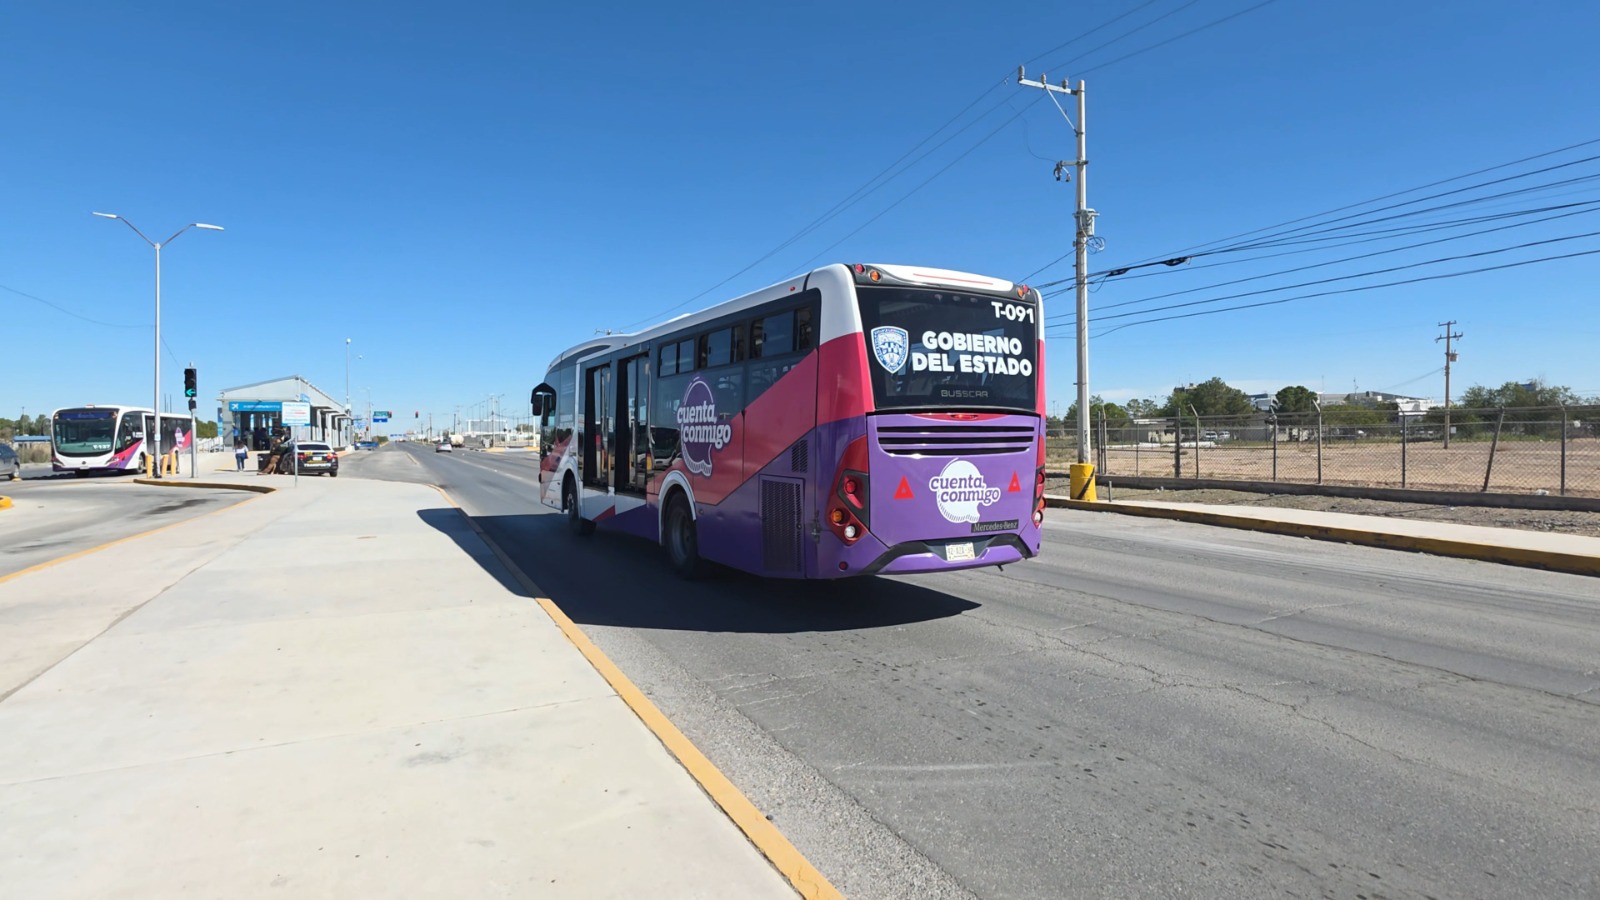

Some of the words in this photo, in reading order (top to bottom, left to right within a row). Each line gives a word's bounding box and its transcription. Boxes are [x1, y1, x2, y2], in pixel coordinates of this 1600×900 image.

[991, 301, 1035, 324] T-091
[921, 330, 1023, 356] GOBIERNO
[911, 352, 955, 373] DEL
[960, 354, 1033, 377] ESTADO
[940, 389, 989, 398] BUSSCAR
[683, 424, 731, 449] conmigo
[940, 489, 1000, 504] conmigo
[973, 521, 1018, 532] Mercedes-Benz
